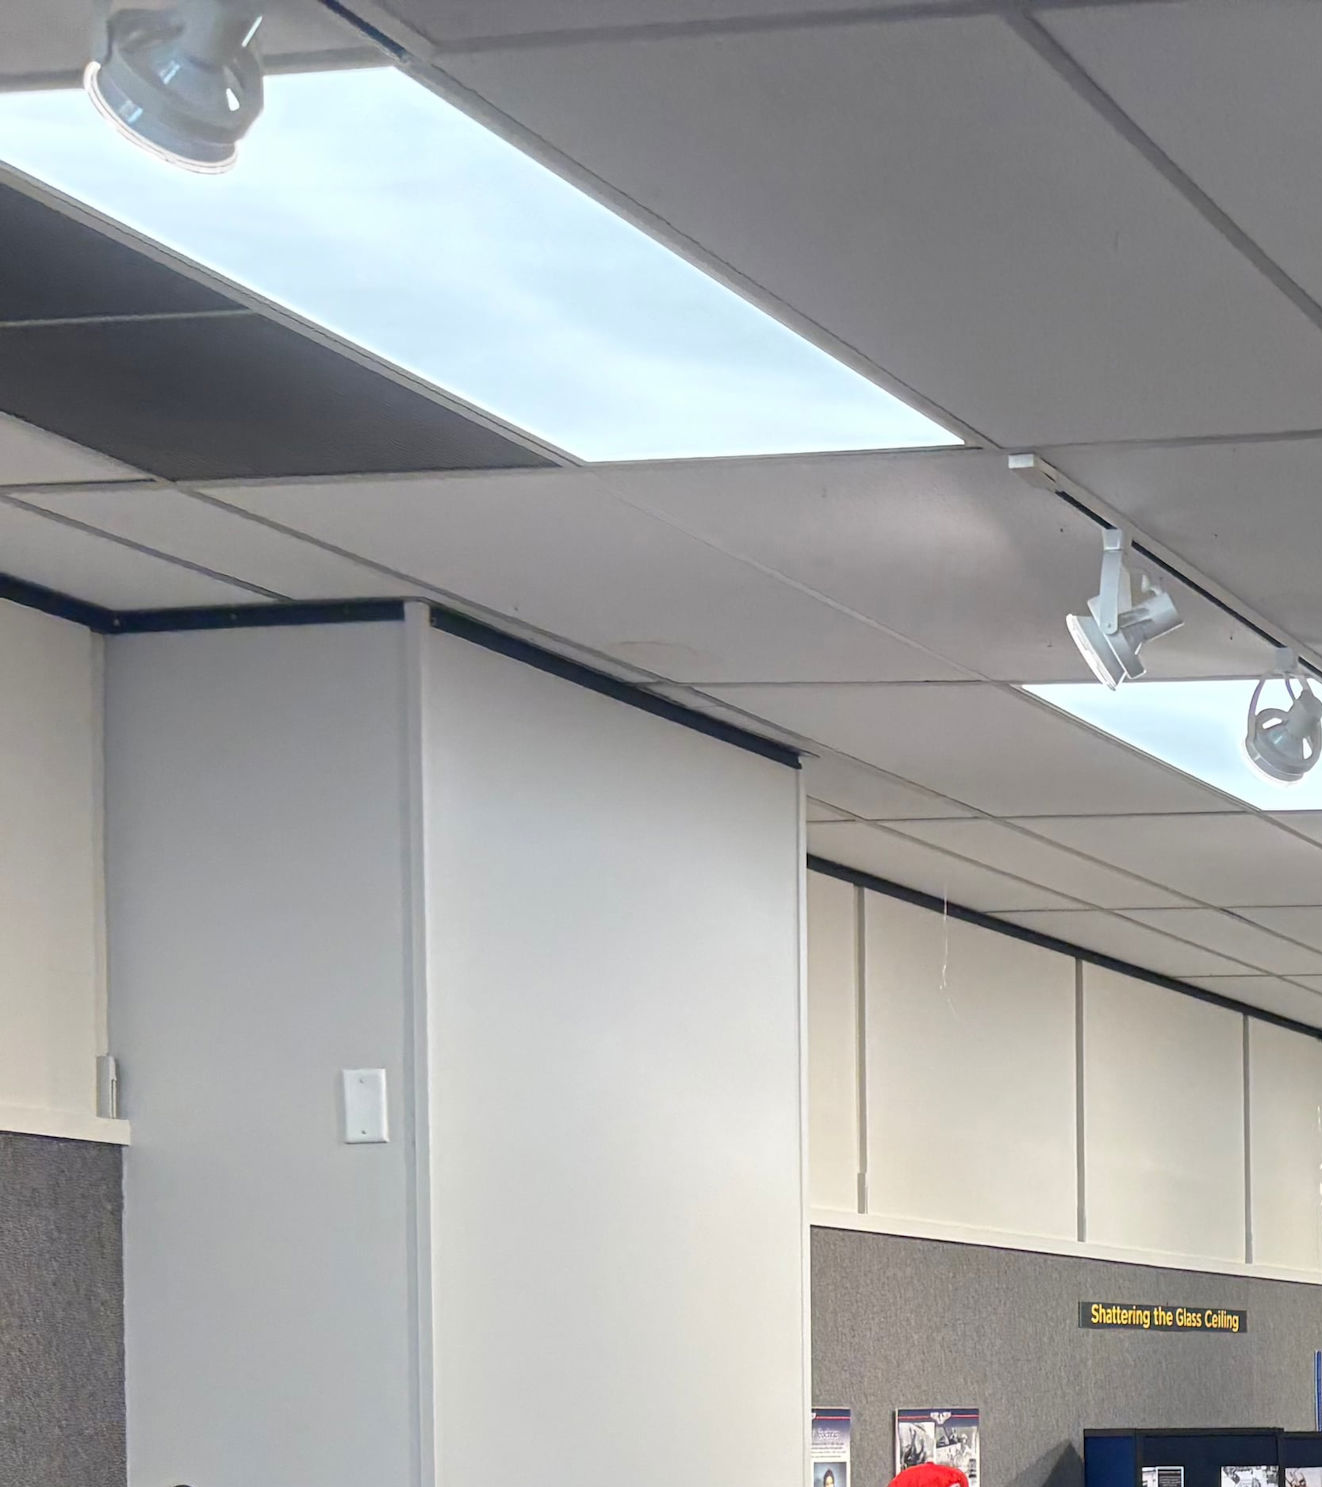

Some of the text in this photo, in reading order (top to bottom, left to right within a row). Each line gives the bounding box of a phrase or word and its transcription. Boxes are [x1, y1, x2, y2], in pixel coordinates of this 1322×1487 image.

[1090, 1303, 1240, 1332] Shattering the Glass Ceiling
